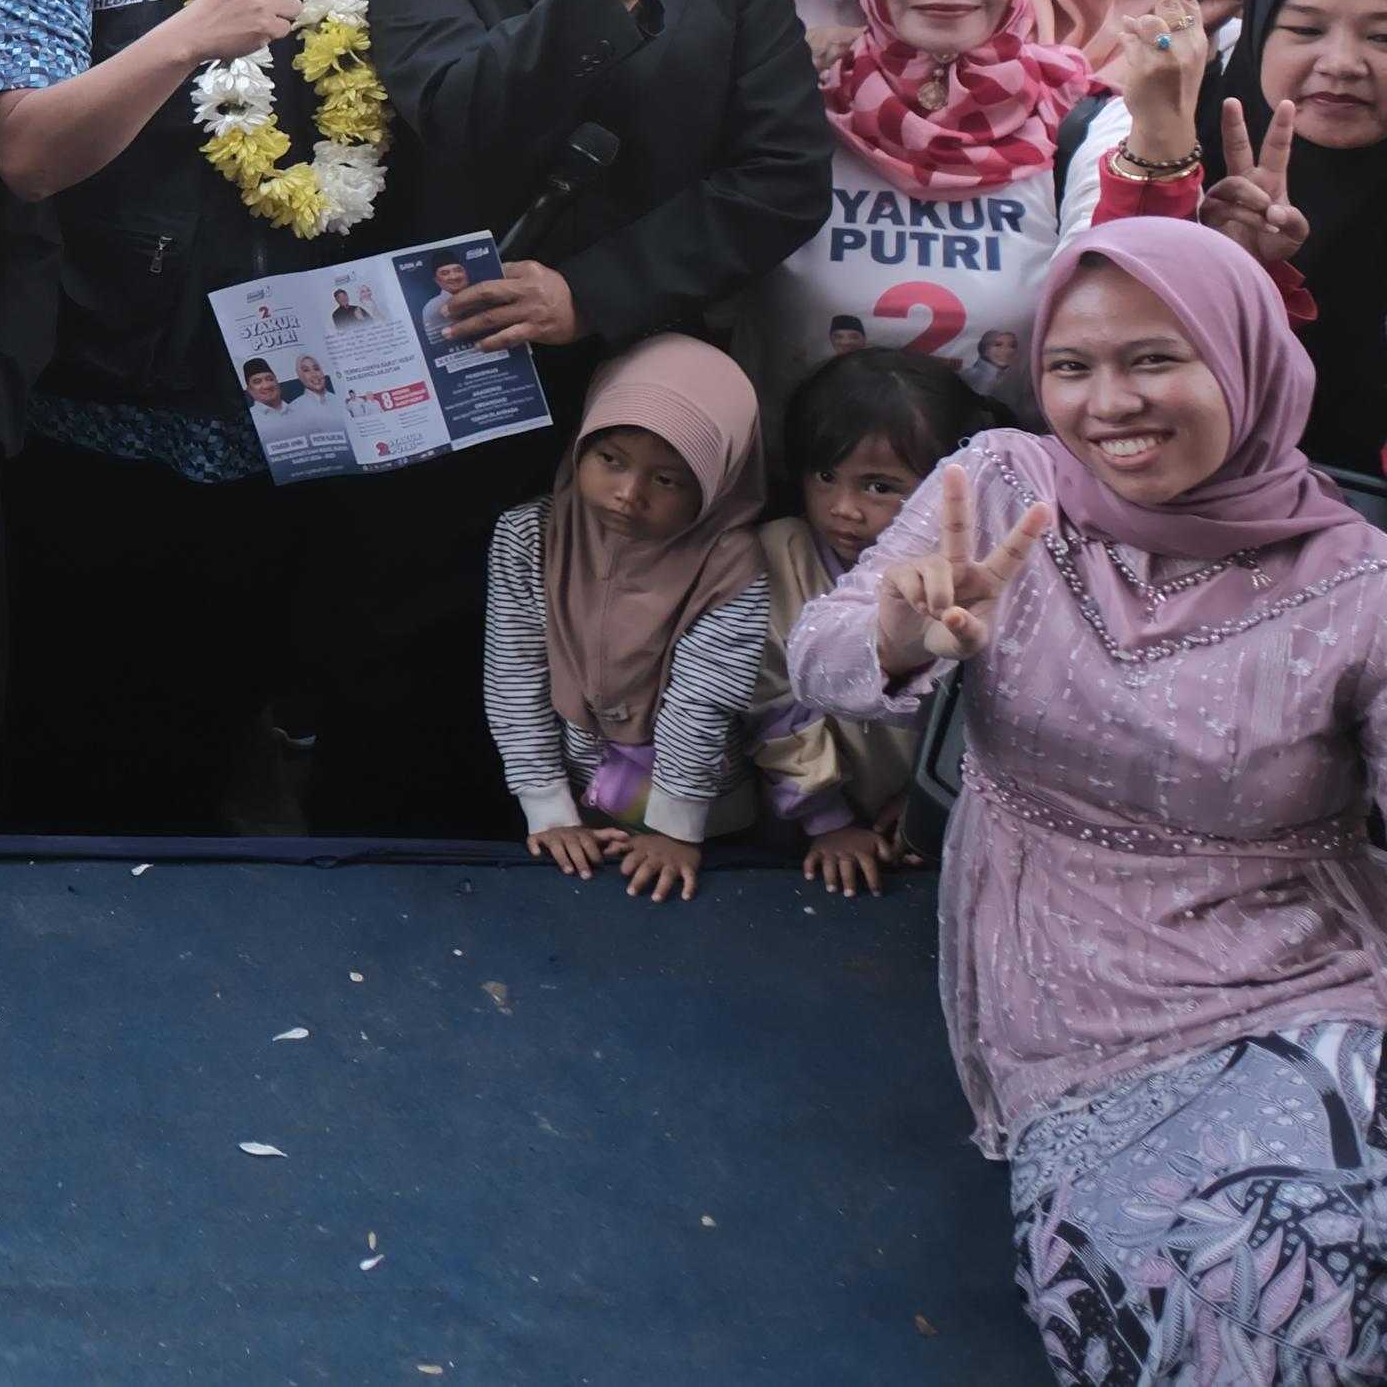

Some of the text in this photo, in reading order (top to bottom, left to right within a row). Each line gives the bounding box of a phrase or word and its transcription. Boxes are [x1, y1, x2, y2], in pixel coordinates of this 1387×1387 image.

[832, 188, 1027, 233] YAKUR
[829, 227, 1002, 272] PUTRI
[258, 306, 272, 319] 2
